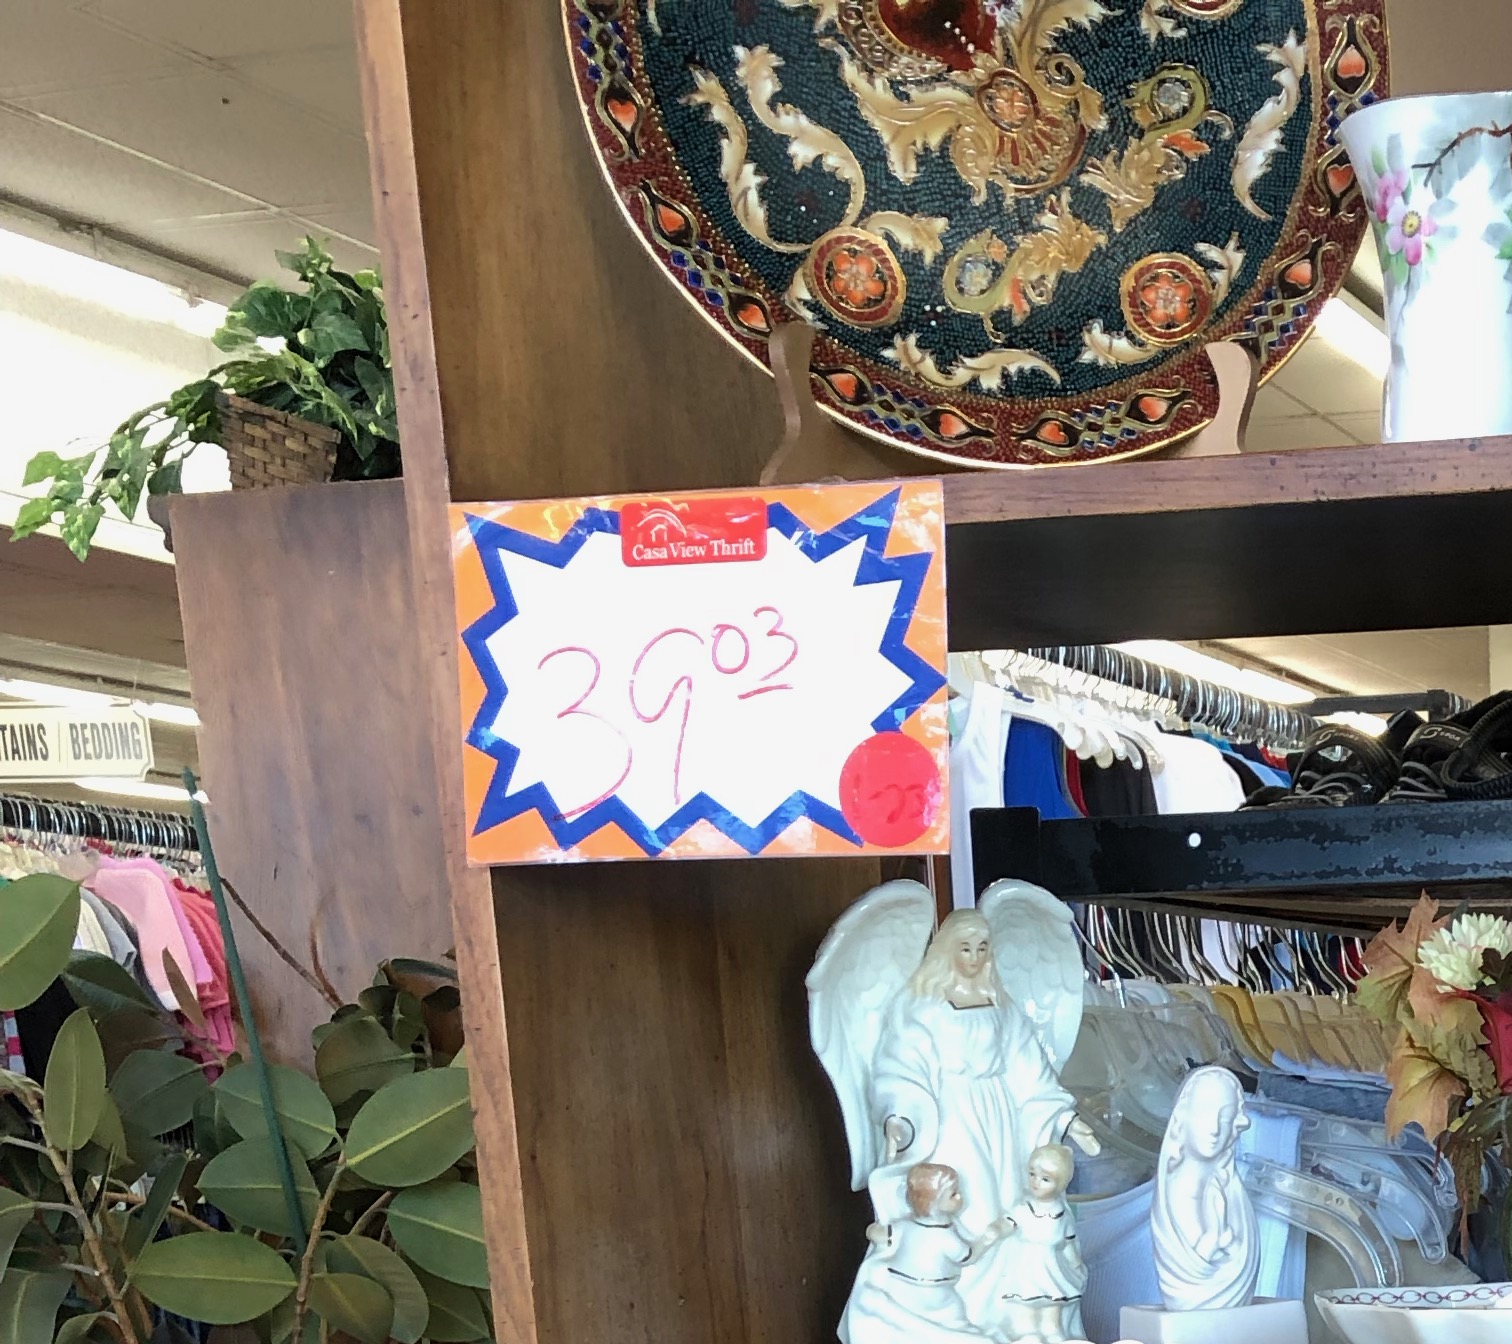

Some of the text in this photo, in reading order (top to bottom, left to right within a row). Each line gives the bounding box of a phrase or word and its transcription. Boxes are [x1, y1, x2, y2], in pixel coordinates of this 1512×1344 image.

[632, 537, 756, 561] Casa View Thrift
[0, 721, 143, 761] TAINS BEDDING
